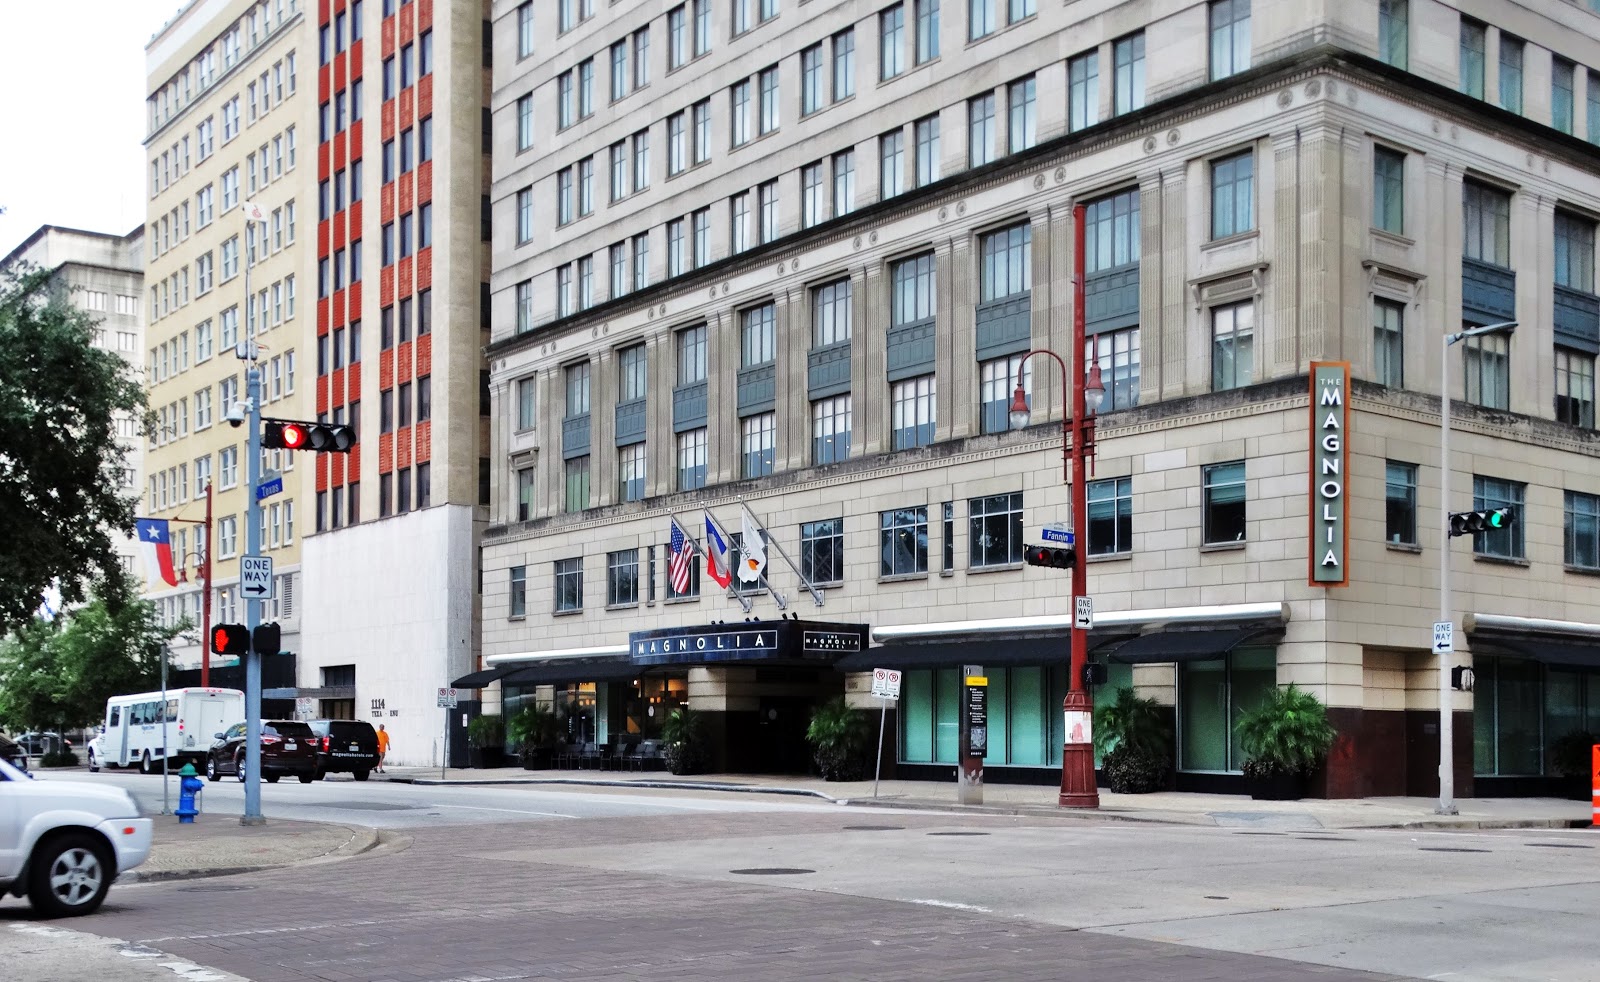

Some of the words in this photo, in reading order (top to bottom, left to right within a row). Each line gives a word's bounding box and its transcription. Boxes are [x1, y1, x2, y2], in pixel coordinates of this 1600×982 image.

[1320, 387, 1342, 566] MAGNOLIA
[261, 483, 280, 497] Texas
[1047, 531, 1068, 542] Fannin
[244, 559, 269, 570] ONE
[244, 572, 269, 582] WAY
[1078, 599, 1091, 607] ONE
[1078, 608, 1091, 616] WAY
[1435, 624, 1451, 632] ONE
[638, 634, 765, 654] MAGNOLIA
[371, 698, 385, 709] 1114
